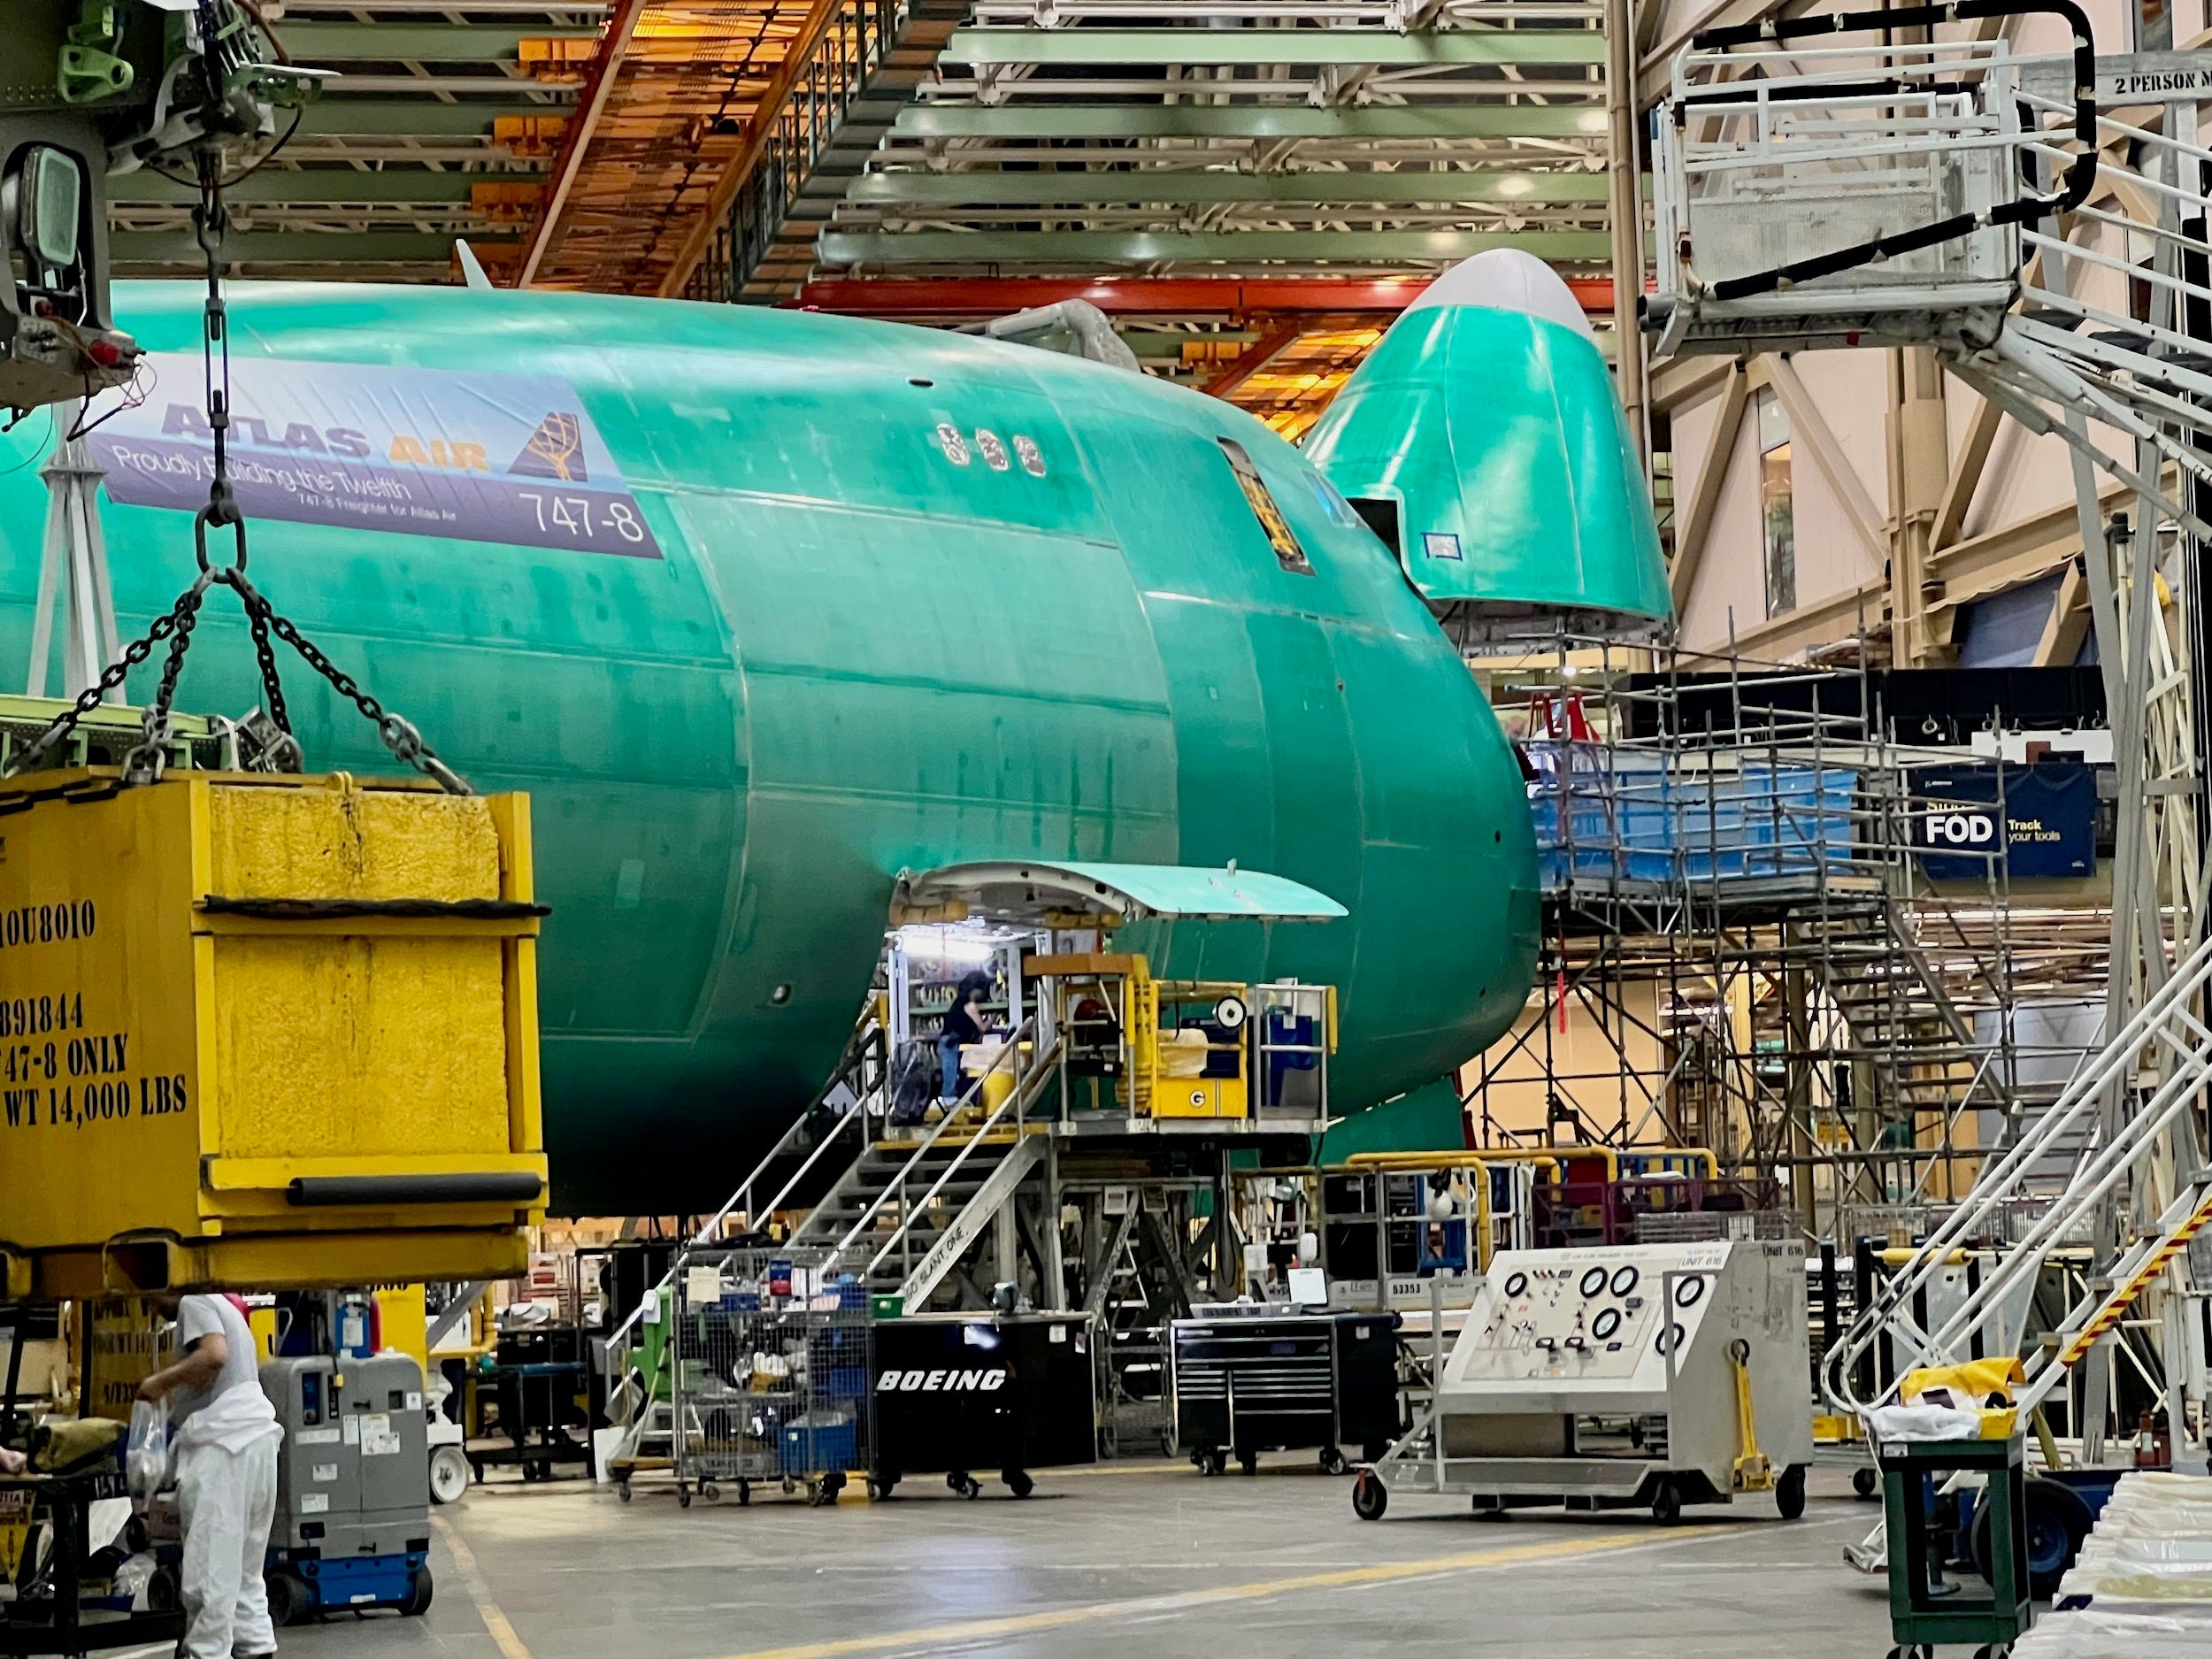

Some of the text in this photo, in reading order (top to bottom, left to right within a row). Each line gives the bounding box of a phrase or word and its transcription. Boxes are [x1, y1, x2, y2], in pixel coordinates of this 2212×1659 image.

[2115, 78, 2126, 95] 2
[2131, 72, 2195, 93] PERSON
[161, 403, 490, 471] ATLAS AIR
[111, 445, 202, 480] Proudly
[296, 466, 334, 491] the
[333, 471, 412, 500] Twelfth
[518, 493, 644, 542] 747-8
[1926, 815, 1993, 843] FOD
[2008, 819, 2042, 831] Track
[2008, 830, 2061, 844] your tools
[0, 1033, 128, 1083] 47-8 ONLY
[4, 1073, 187, 1130] WT 14,000 LBS
[876, 1369, 1007, 1391] BOEING
